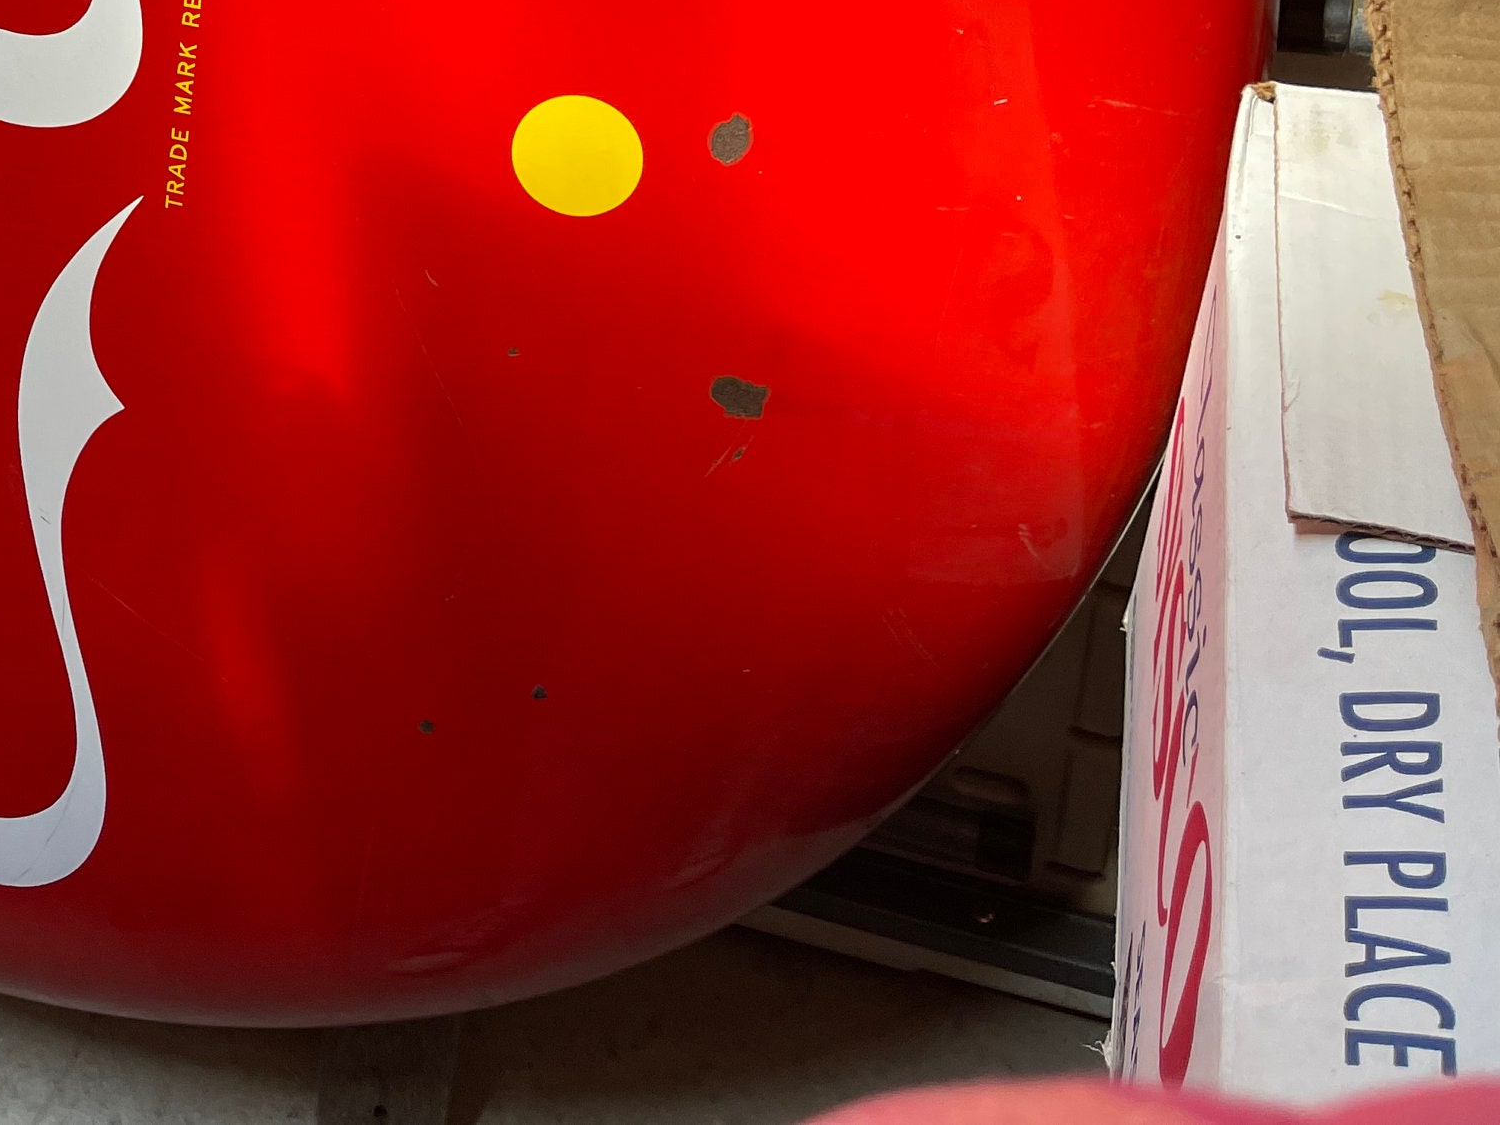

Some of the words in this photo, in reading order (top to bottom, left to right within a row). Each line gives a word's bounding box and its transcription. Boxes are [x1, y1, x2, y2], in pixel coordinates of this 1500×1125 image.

[173, 41, 198, 115] MARK
[165, 127, 190, 209] TRADE
[1338, 691, 1446, 825] DRY
[1342, 850, 1459, 1080] PLACE
